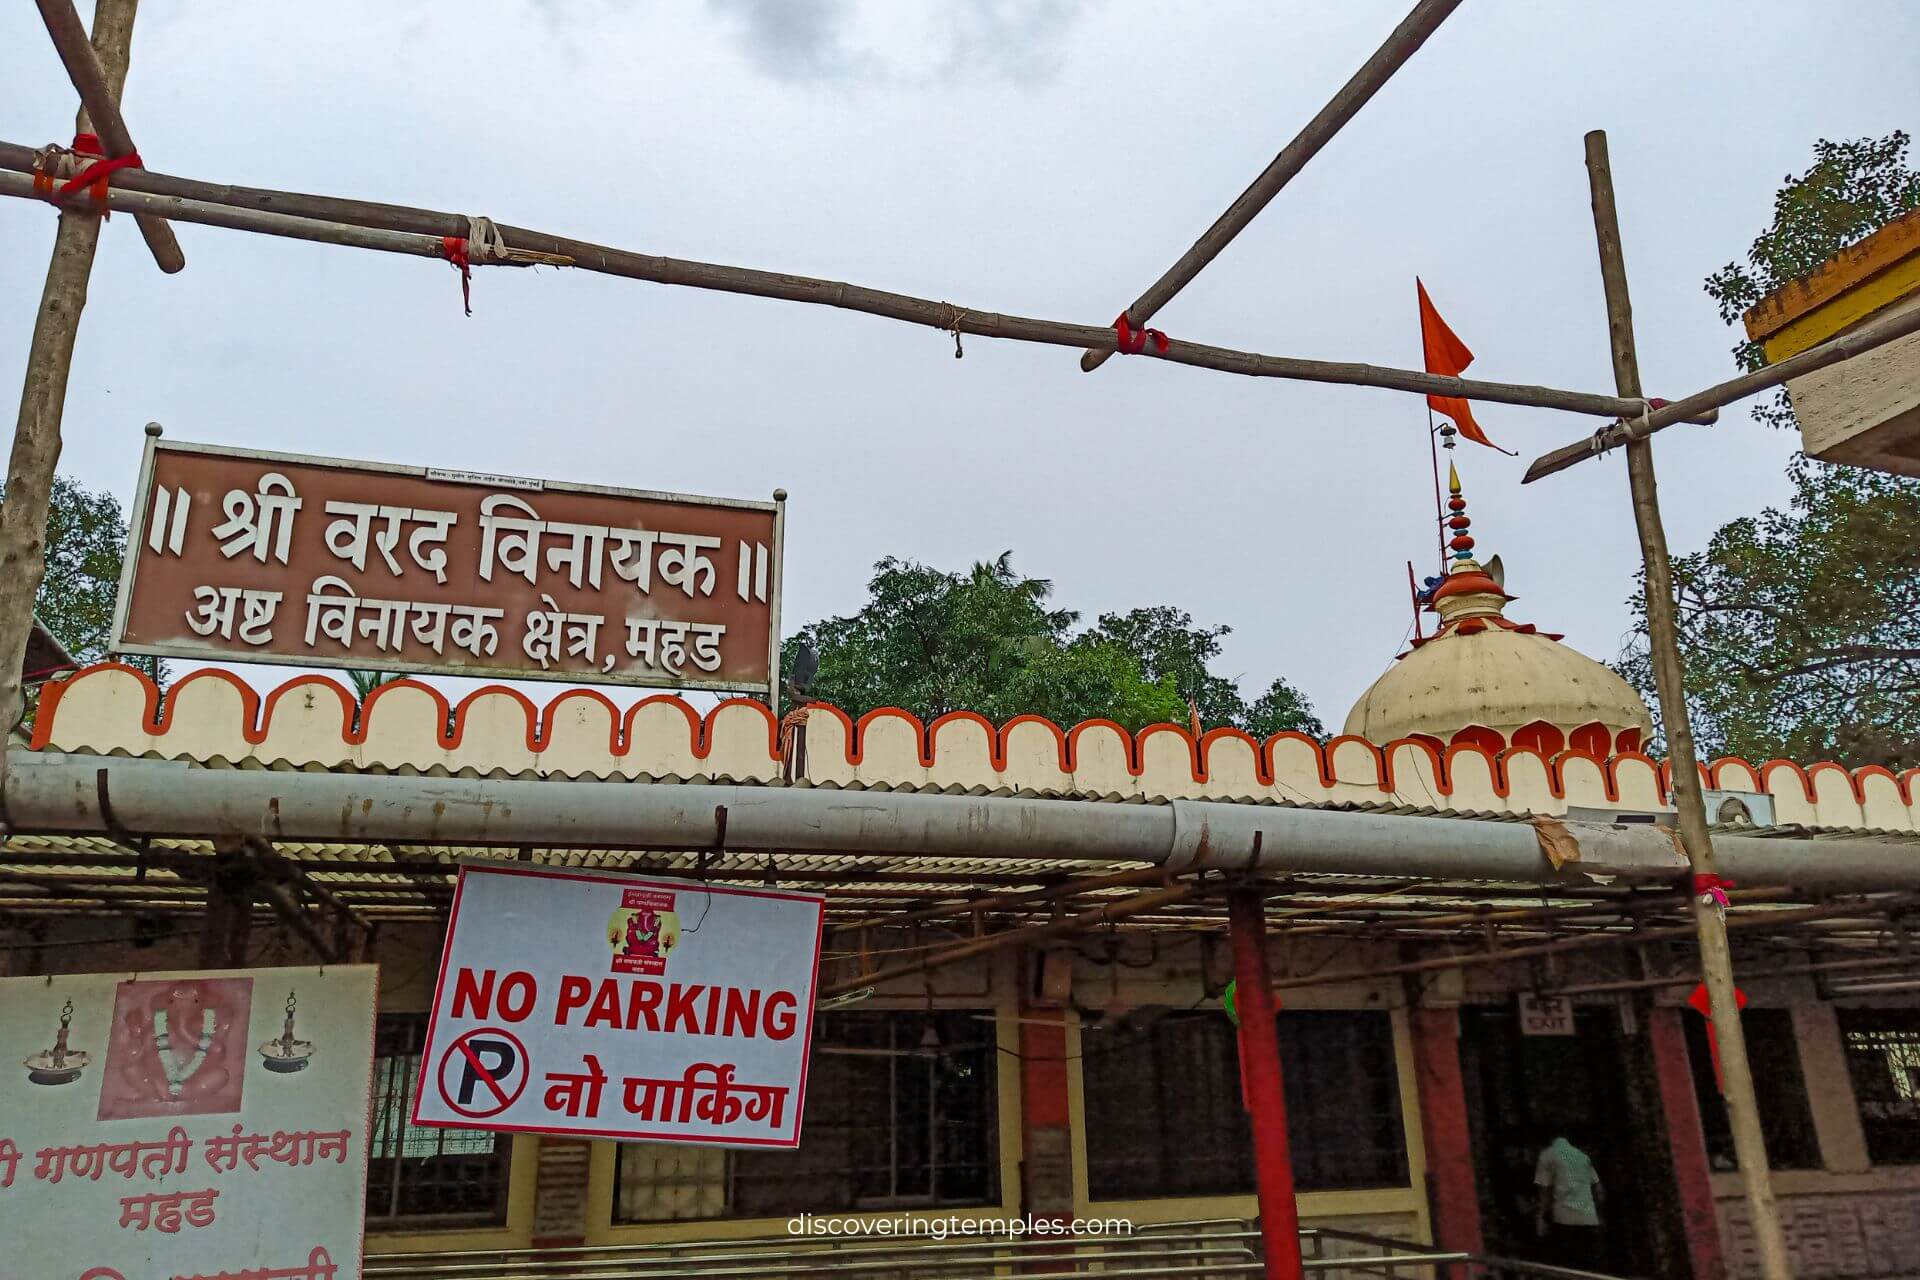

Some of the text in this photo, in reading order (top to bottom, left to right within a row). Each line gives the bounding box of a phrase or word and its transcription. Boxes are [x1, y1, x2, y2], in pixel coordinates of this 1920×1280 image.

[212, 473, 302, 565] श्री
[325, 501, 457, 583] वरद
[479, 495, 721, 598] विनायक
[186, 585, 282, 645] अष्ट
[305, 576, 504, 657] विनायक
[625, 617, 725, 676] महड
[451, 968, 797, 1040] NO PARKING
[544, 1055, 789, 1128] नो पार्किंग
[34, 1126, 193, 1184] गणपती
[205, 1124, 352, 1174] संस्थान
[119, 1188, 220, 1234] महड
